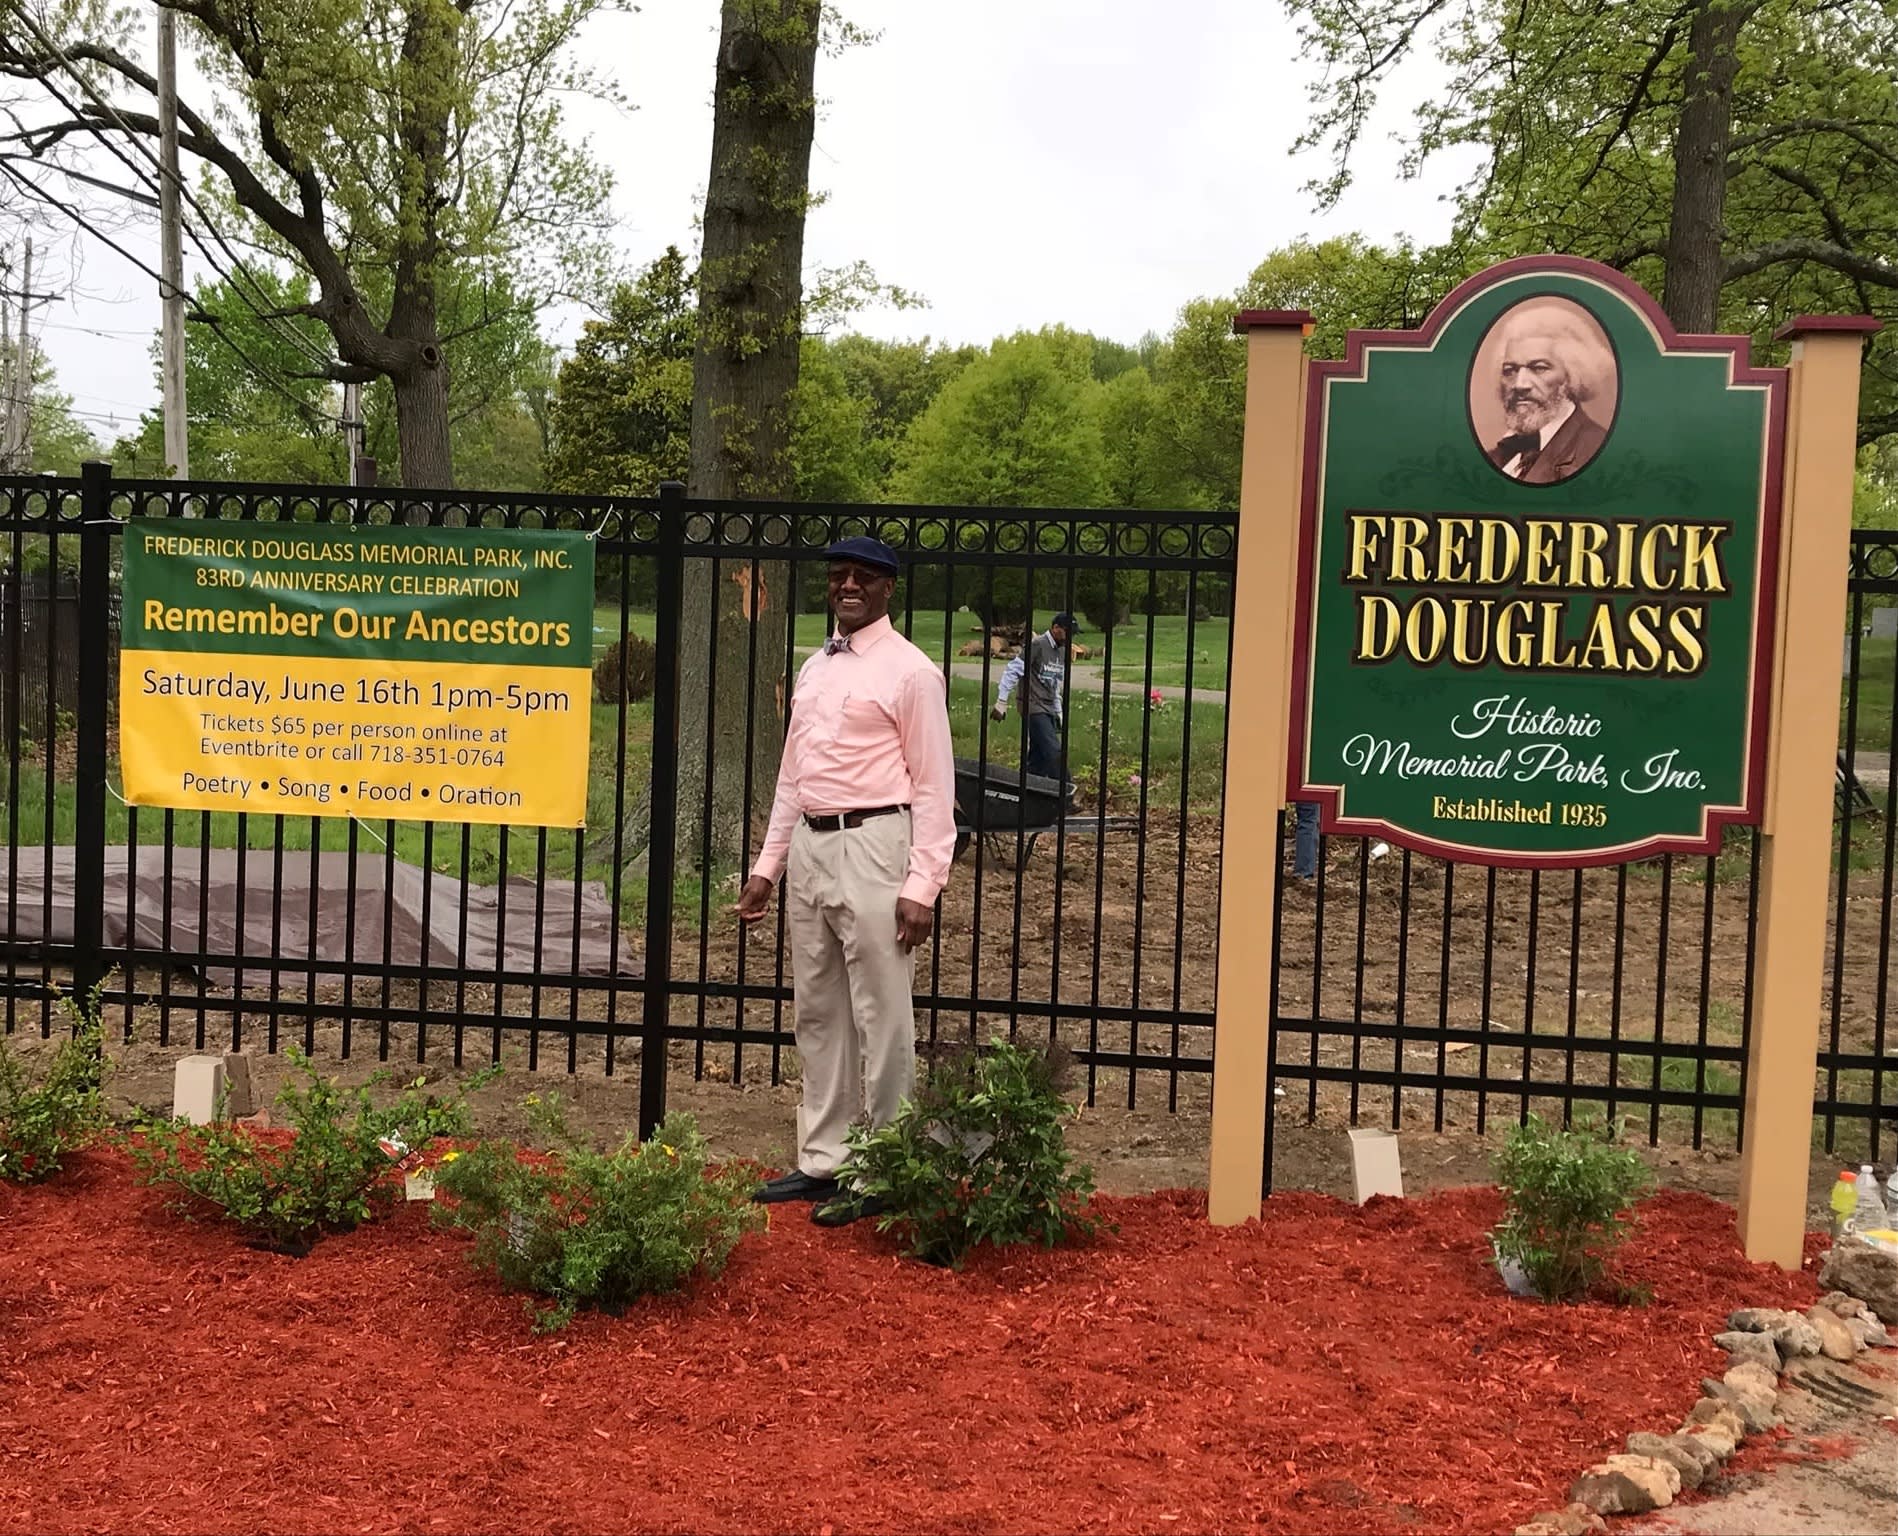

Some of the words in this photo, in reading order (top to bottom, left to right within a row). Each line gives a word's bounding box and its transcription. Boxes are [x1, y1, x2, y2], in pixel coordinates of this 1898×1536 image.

[144, 535, 246, 558] FREDERICK
[252, 540, 355, 562] DOUGLASS
[360, 543, 469, 566] MEMORIAL
[474, 547, 528, 571] PARK,
[534, 549, 573, 569] INC.
[1347, 516, 1726, 591] FREDERICK
[196, 567, 246, 588] 83RD
[249, 570, 385, 593] ANNIVERSARY
[390, 575, 519, 598] CELEBRATION
[144, 599, 324, 637] Remember
[333, 606, 396, 640] Our
[404, 610, 571, 647] Ancestors
[1358, 597, 1702, 672] DOUGLASS
[143, 669, 270, 705] Saturday,
[279, 675, 345, 702] June
[357, 679, 419, 705] 16th
[431, 681, 569, 716] 1pm-5pm
[200, 713, 265, 733] Tickets
[271, 714, 306, 735] $65
[312, 722, 345, 739] per
[351, 724, 416, 741] person
[422, 723, 483, 742] online
[489, 727, 508, 743] at
[1451, 695, 1601, 738] Historic
[201, 737, 299, 759] Eventbrite
[305, 746, 326, 759] or
[332, 743, 363, 761] call
[370, 745, 505, 767] 718-351-0764
[1341, 733, 1509, 780] Memorial
[1513, 744, 1608, 788] Park,
[1621, 749, 1707, 793] Inc.
[183, 772, 252, 799] Poetry
[278, 776, 331, 803] Song
[358, 780, 412, 802] Food
[439, 784, 521, 806] Oration
[1434, 797, 1551, 823] Established
[1562, 804, 1606, 826] 1935
